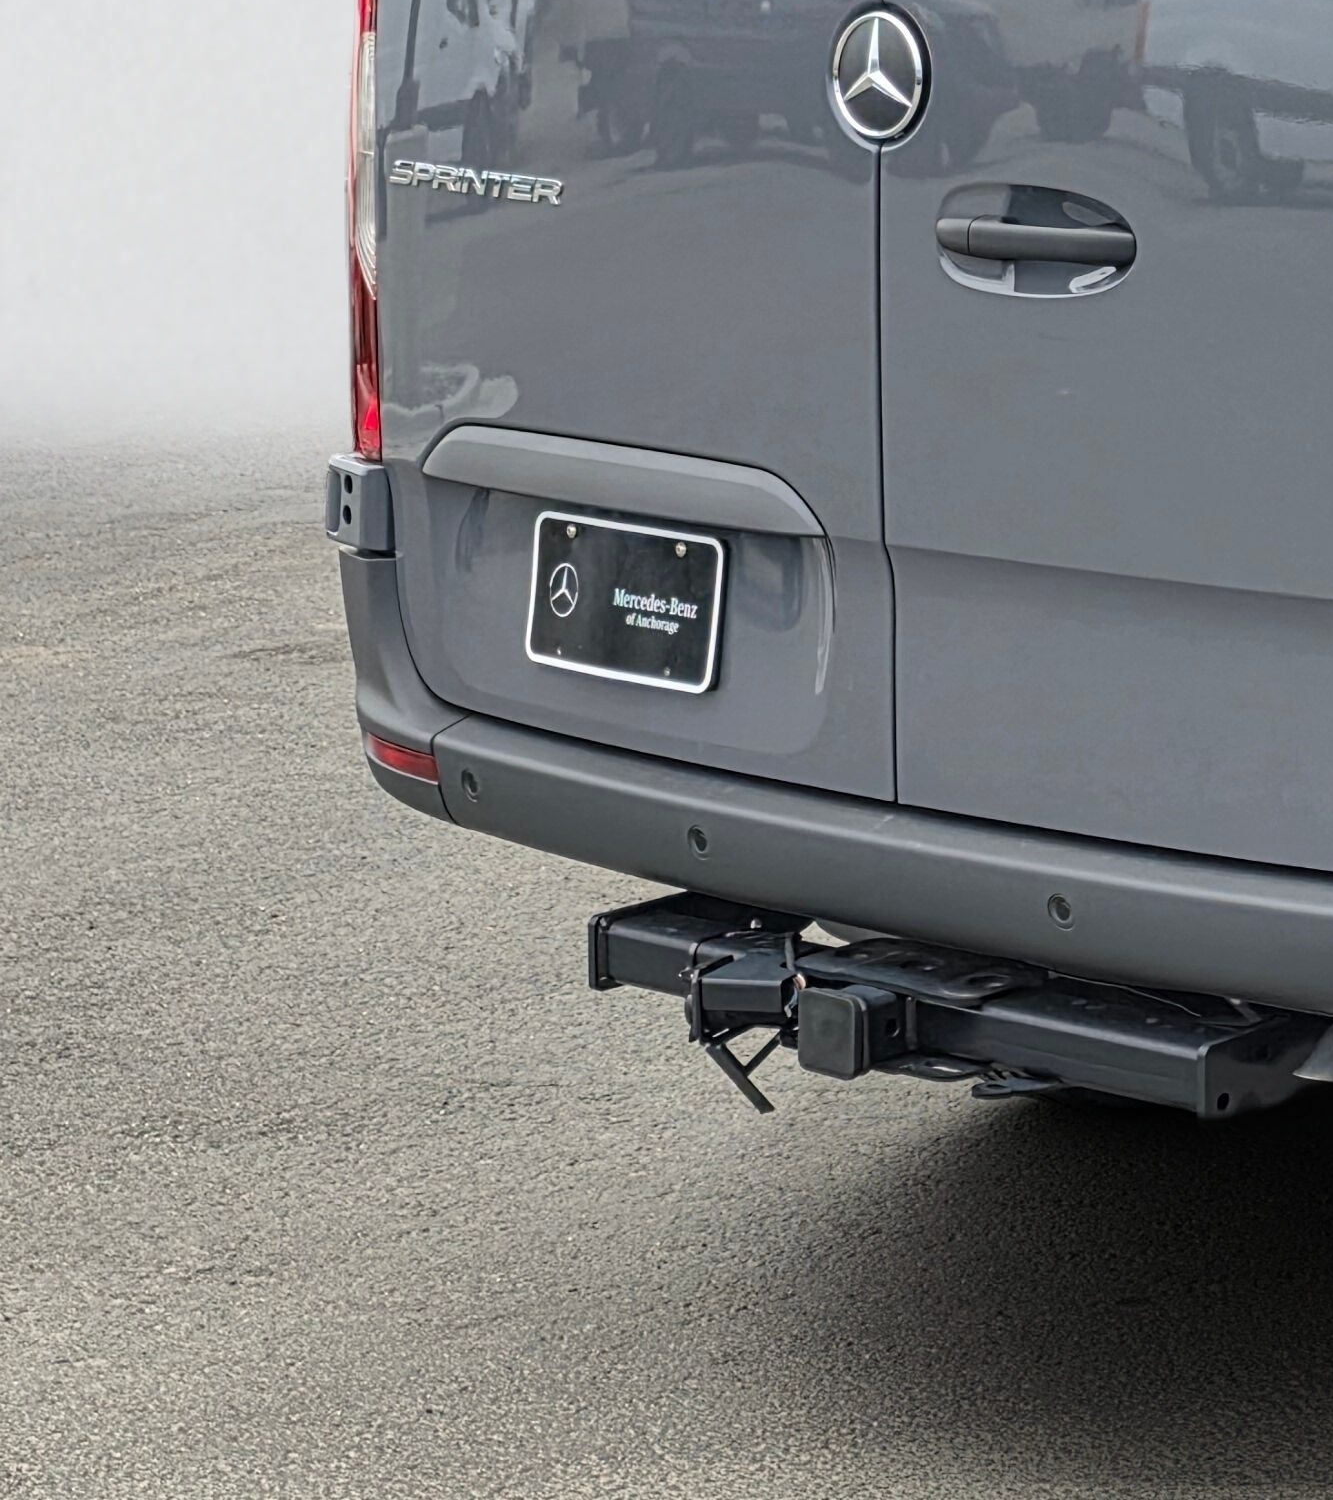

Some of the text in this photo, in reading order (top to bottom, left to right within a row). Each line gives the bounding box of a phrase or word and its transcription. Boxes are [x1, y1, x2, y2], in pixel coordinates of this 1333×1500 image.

[389, 159, 564, 206] SPRINTER
[613, 588, 699, 619] Mercedes-Benz
[626, 614, 679, 635] of Anchorage
